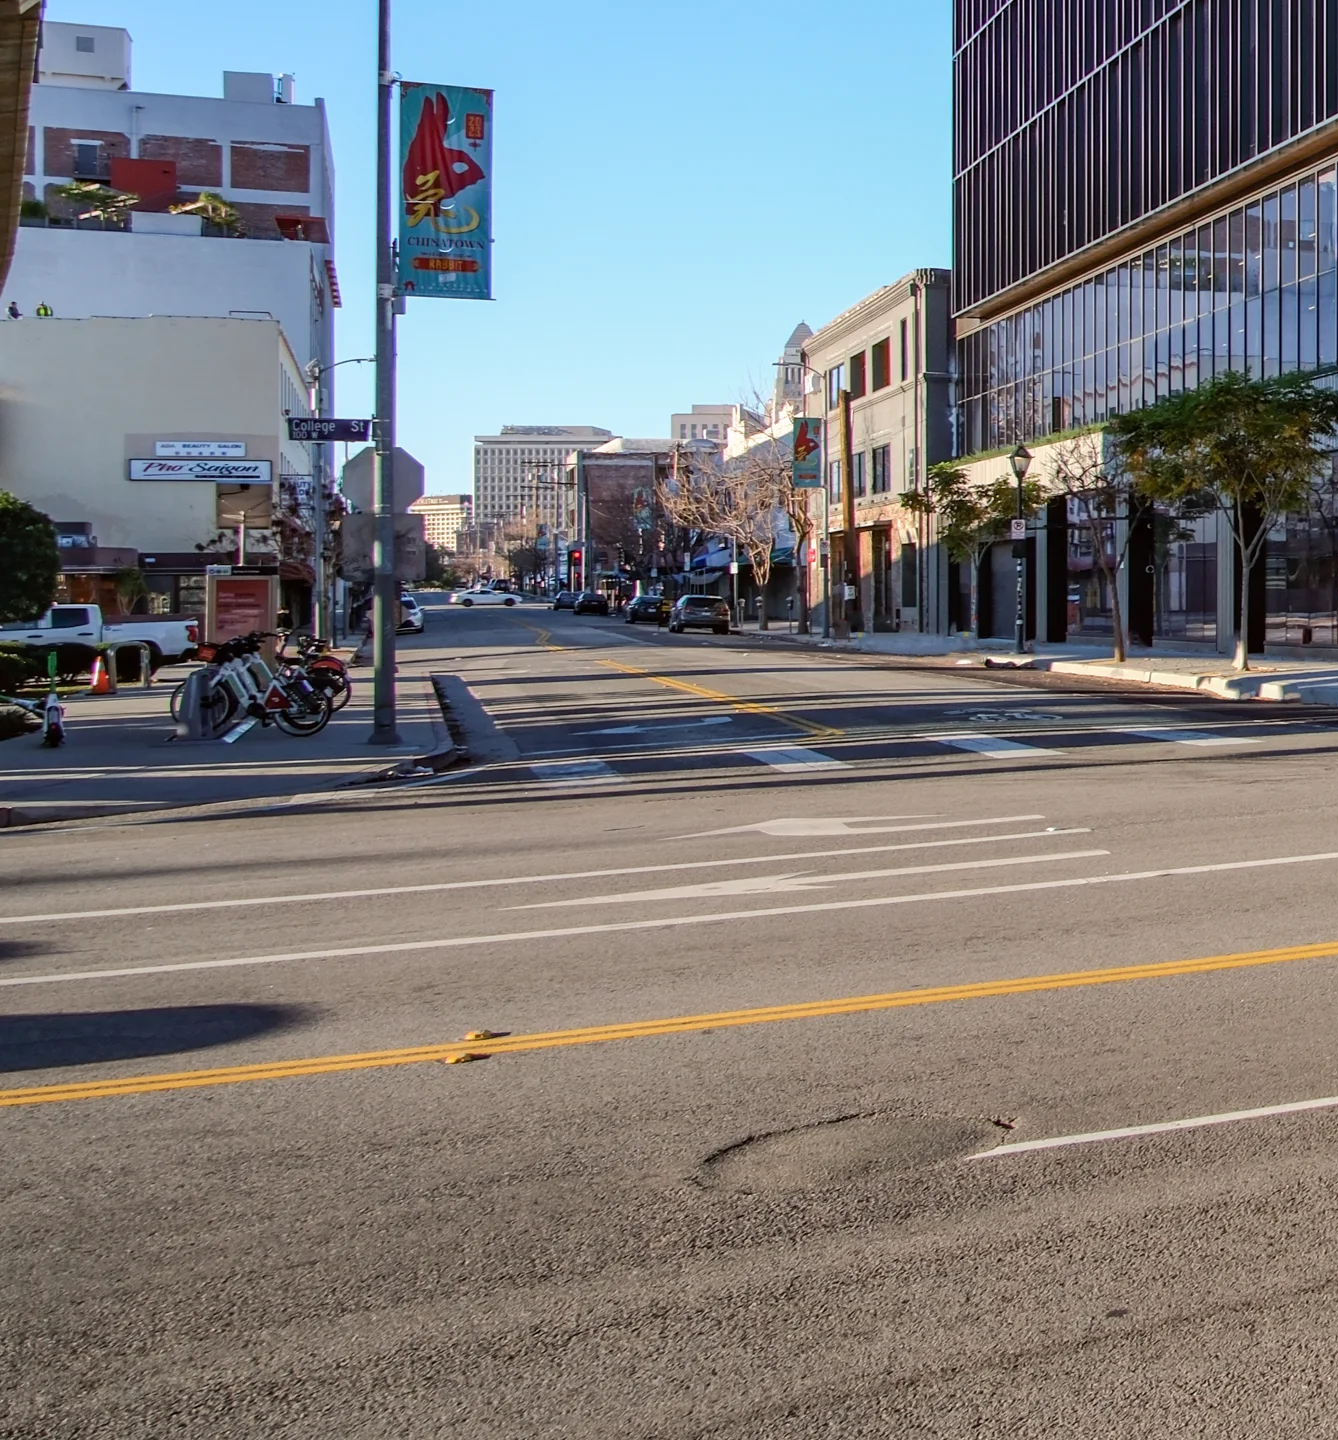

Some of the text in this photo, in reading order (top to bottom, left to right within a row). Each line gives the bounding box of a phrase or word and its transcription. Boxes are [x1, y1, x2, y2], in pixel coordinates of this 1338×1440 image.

[407, 236, 485, 250] CHINATOWN
[429, 259, 464, 270] RABBIT
[292, 420, 365, 435] College St
[292, 431, 308, 439] 100
[188, 462, 260, 475] Saigon
